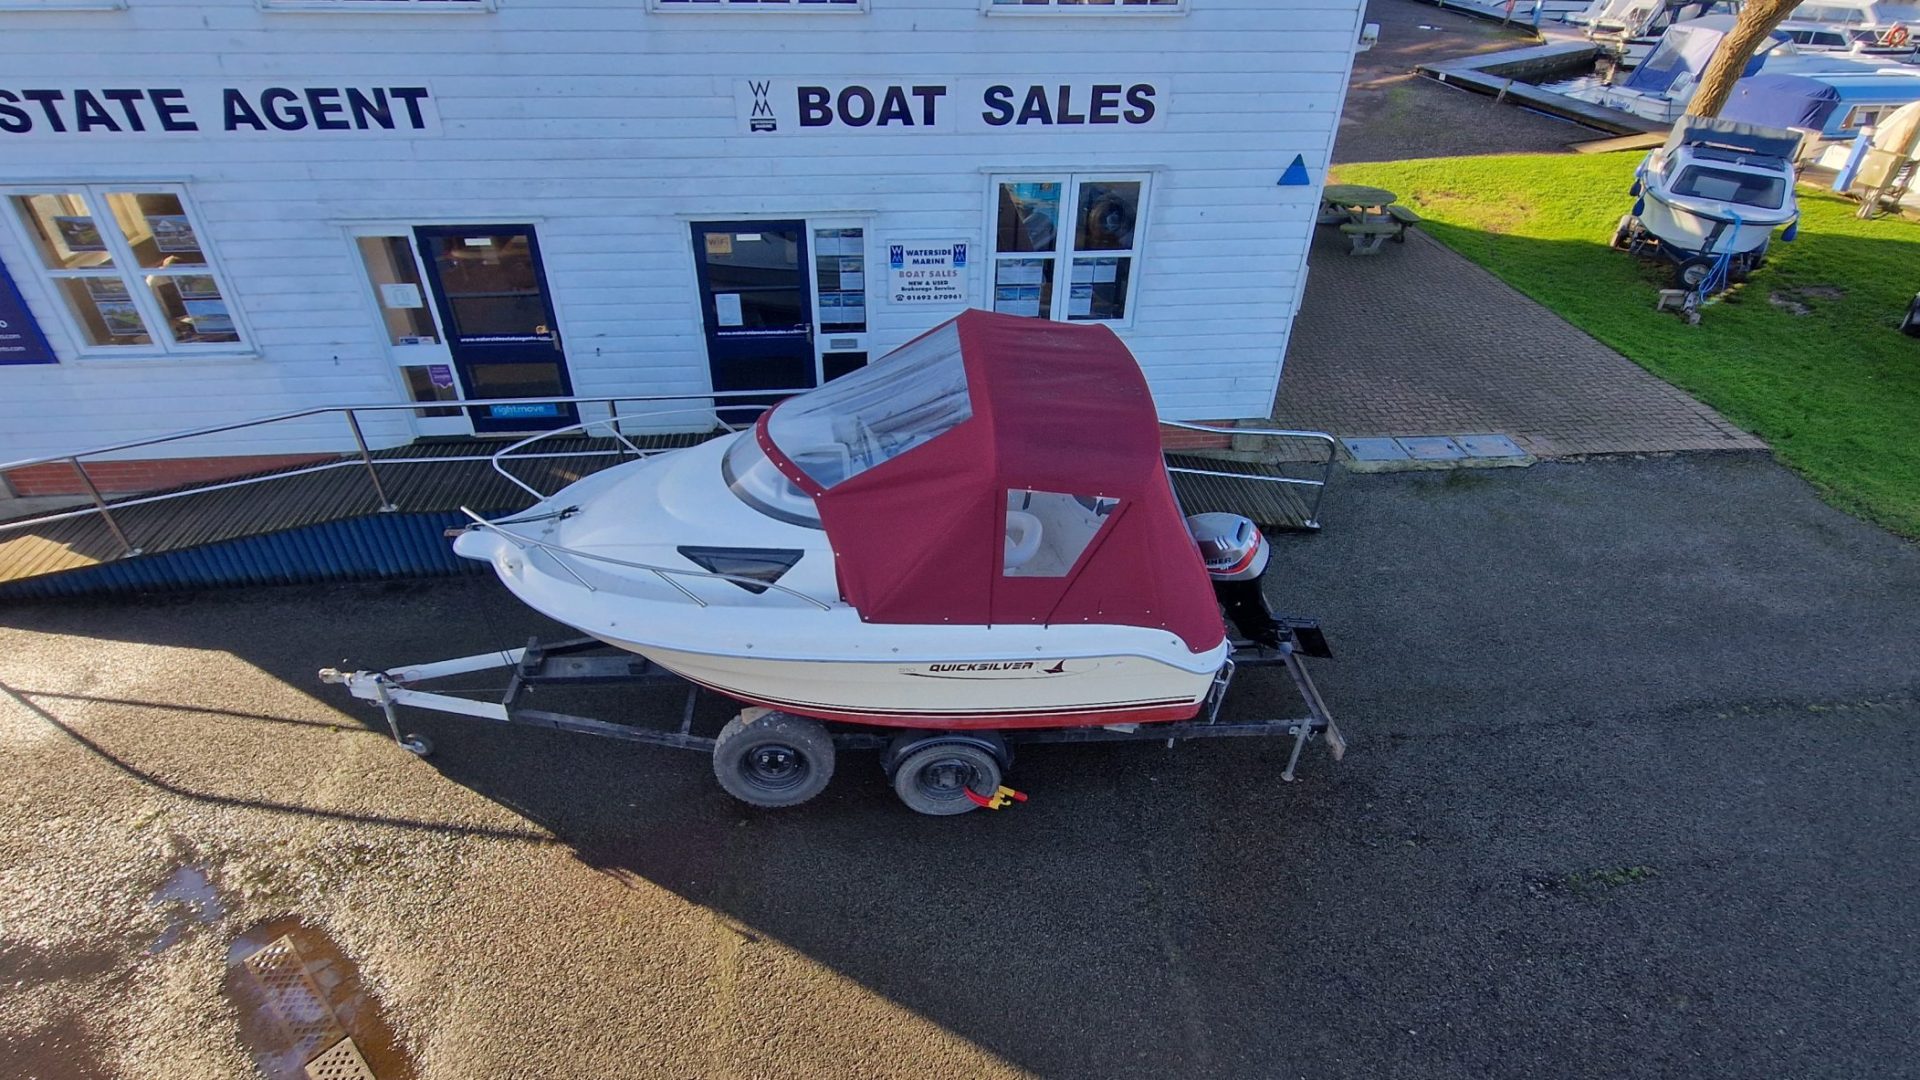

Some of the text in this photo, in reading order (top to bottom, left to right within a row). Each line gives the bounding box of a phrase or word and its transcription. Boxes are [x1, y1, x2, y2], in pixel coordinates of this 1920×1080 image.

[0, 87, 429, 133] STATE AGENT
[797, 84, 1156, 127] BOAT SALES
[899, 270, 926, 278] BOAT
[494, 405, 545, 416] rightmove
[929, 661, 1034, 673] QUICKSILVER
